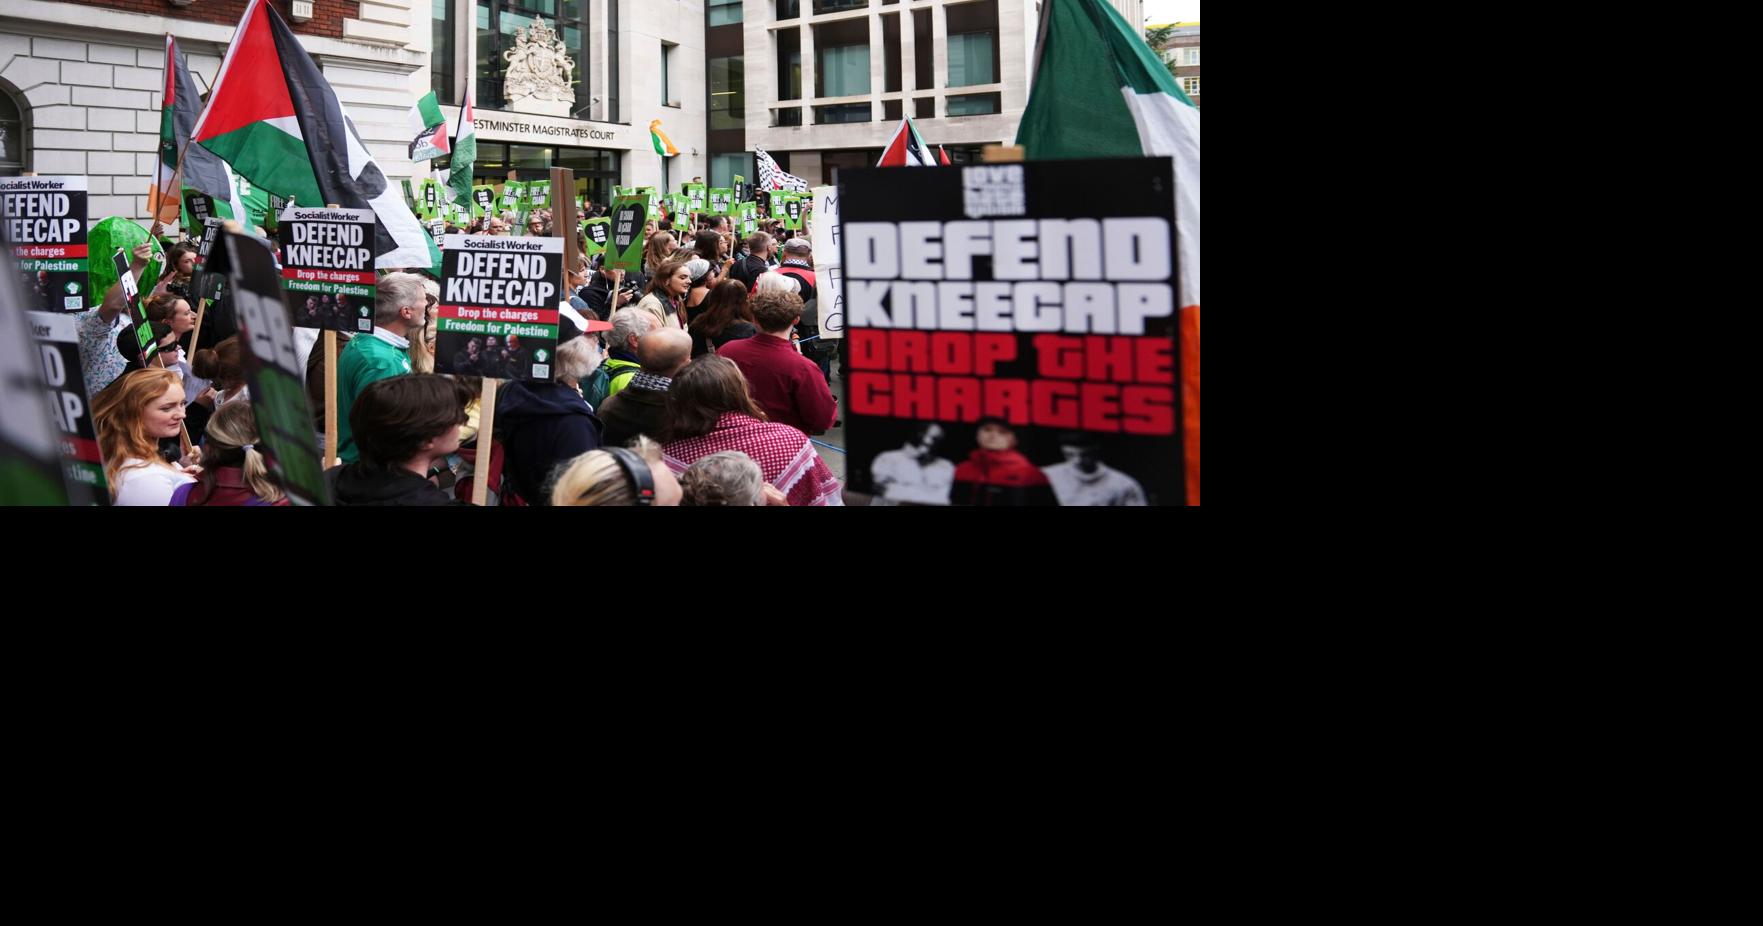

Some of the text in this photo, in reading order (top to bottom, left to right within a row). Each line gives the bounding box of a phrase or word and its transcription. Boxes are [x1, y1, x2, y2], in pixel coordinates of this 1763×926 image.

[474, 119, 615, 140] ESTMINSTER MAGISTRATES COURT
[0, 180, 64, 190] ocialist Worker
[0, 193, 70, 217] EFEND
[294, 211, 330, 220] Socialist
[330, 212, 360, 221] Worker
[3, 218, 80, 243] EECAP
[291, 222, 364, 246] DEFEND
[30, 246, 65, 257] charges
[464, 239, 543, 251] Socialist Worker
[844, 217, 1171, 281] DEFEND
[34, 260, 79, 271] Palestine
[286, 244, 371, 270] KNEECAP
[457, 251, 547, 280] DEFEND
[297, 269, 360, 283] Drop the charges
[288, 279, 369, 296] Freedom for Palestine
[446, 277, 555, 307] KNEECAP
[458, 306, 539, 322] Drop the charges
[846, 280, 1174, 335] KNEECAP
[445, 319, 549, 337] Freedom for Palestine
[848, 327, 1174, 383] DROP THE
[849, 371, 1175, 436] CHARGES
